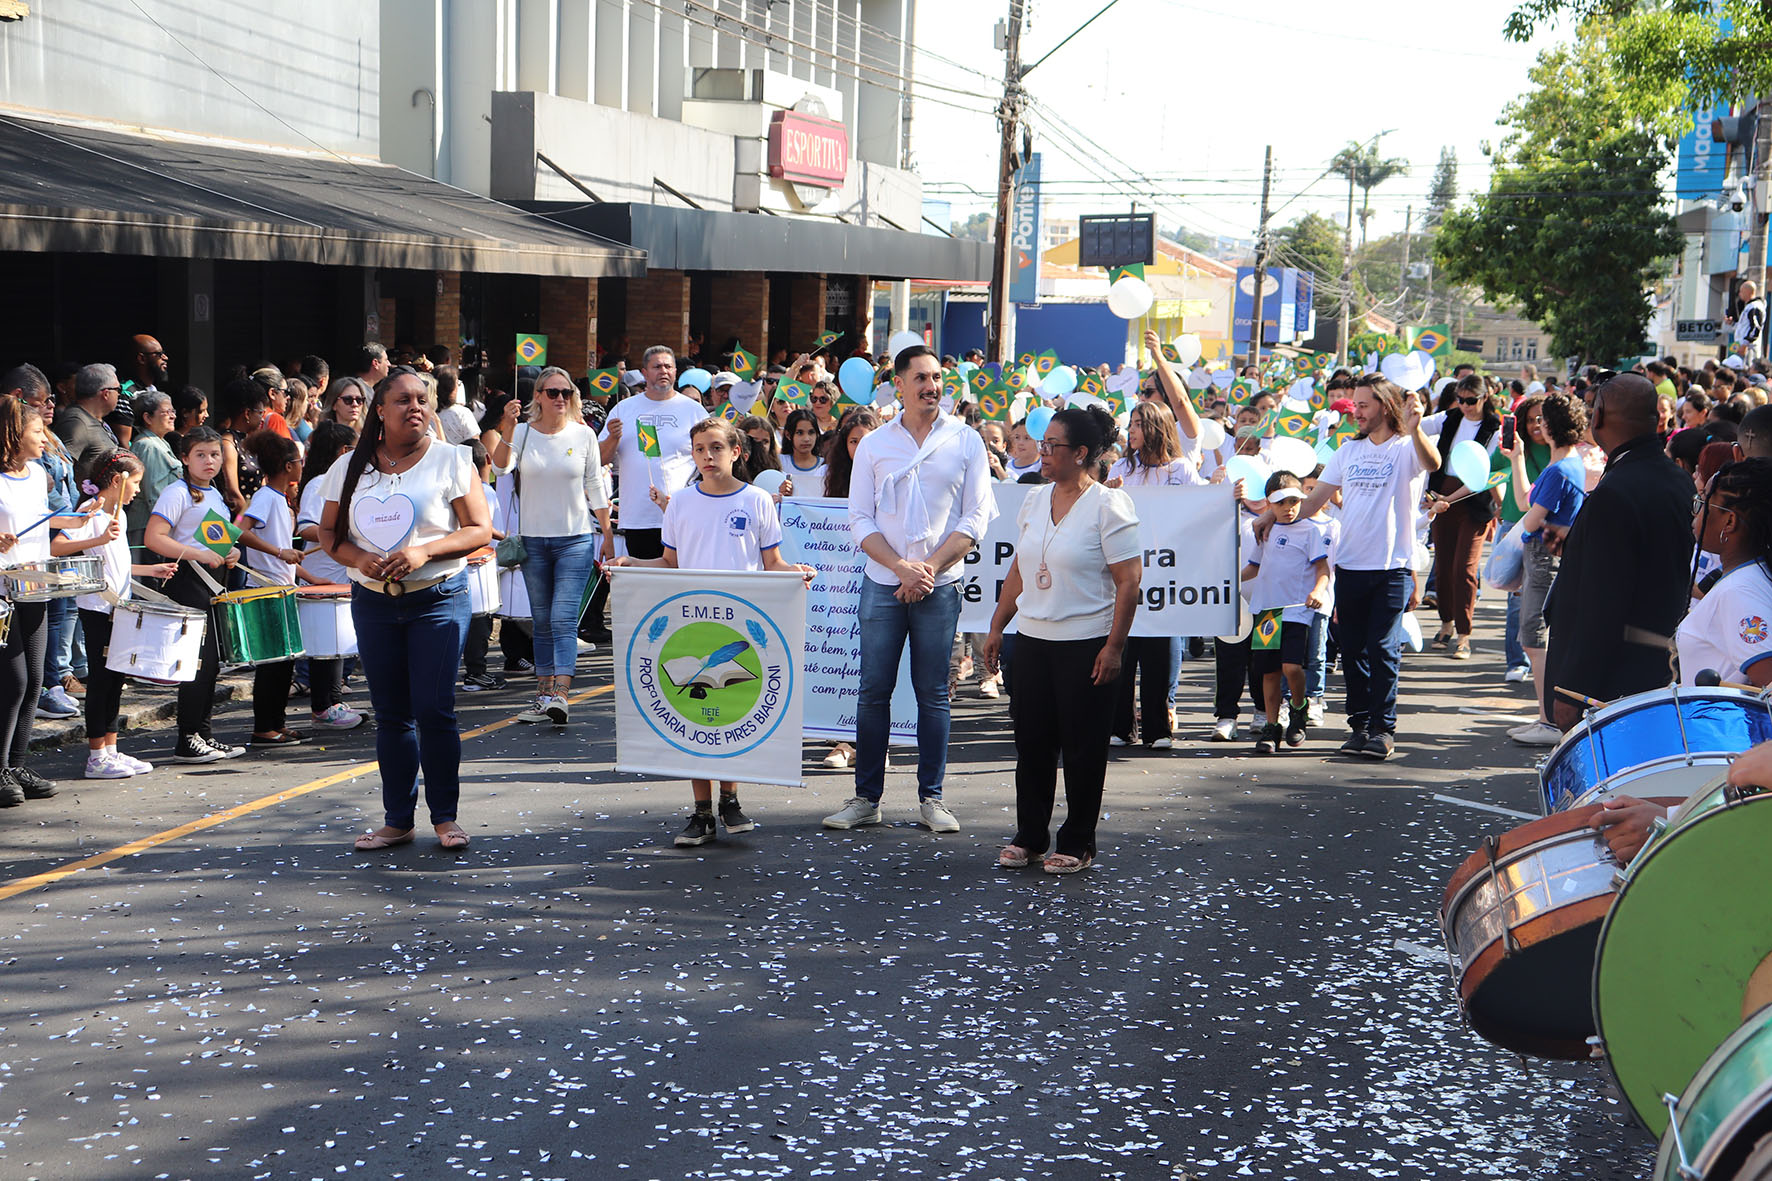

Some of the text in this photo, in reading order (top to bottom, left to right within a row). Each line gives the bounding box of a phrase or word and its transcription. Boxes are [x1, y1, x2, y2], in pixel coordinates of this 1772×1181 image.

[786, 129, 844, 172] ESPORTIVA
[1679, 322, 1713, 333] BETO
[783, 515, 851, 534] As palavra
[804, 541, 837, 552] então
[838, 542, 852, 552] só
[815, 562, 835, 572] seu
[812, 584, 828, 592] as
[682, 605, 734, 620] E.M.E.B
[811, 604, 857, 618] as posit
[826, 625, 849, 638] que
[804, 642, 819, 652] ão
[822, 662, 861, 680] confun
[812, 685, 860, 699] com pre
[650, 699, 686, 738] MARIA
[688, 729, 721, 746] JOSÉ
[724, 720, 757, 743] PIRES
[755, 664, 782, 725] BIAGIONI
[889, 720, 917, 729] ncelos
